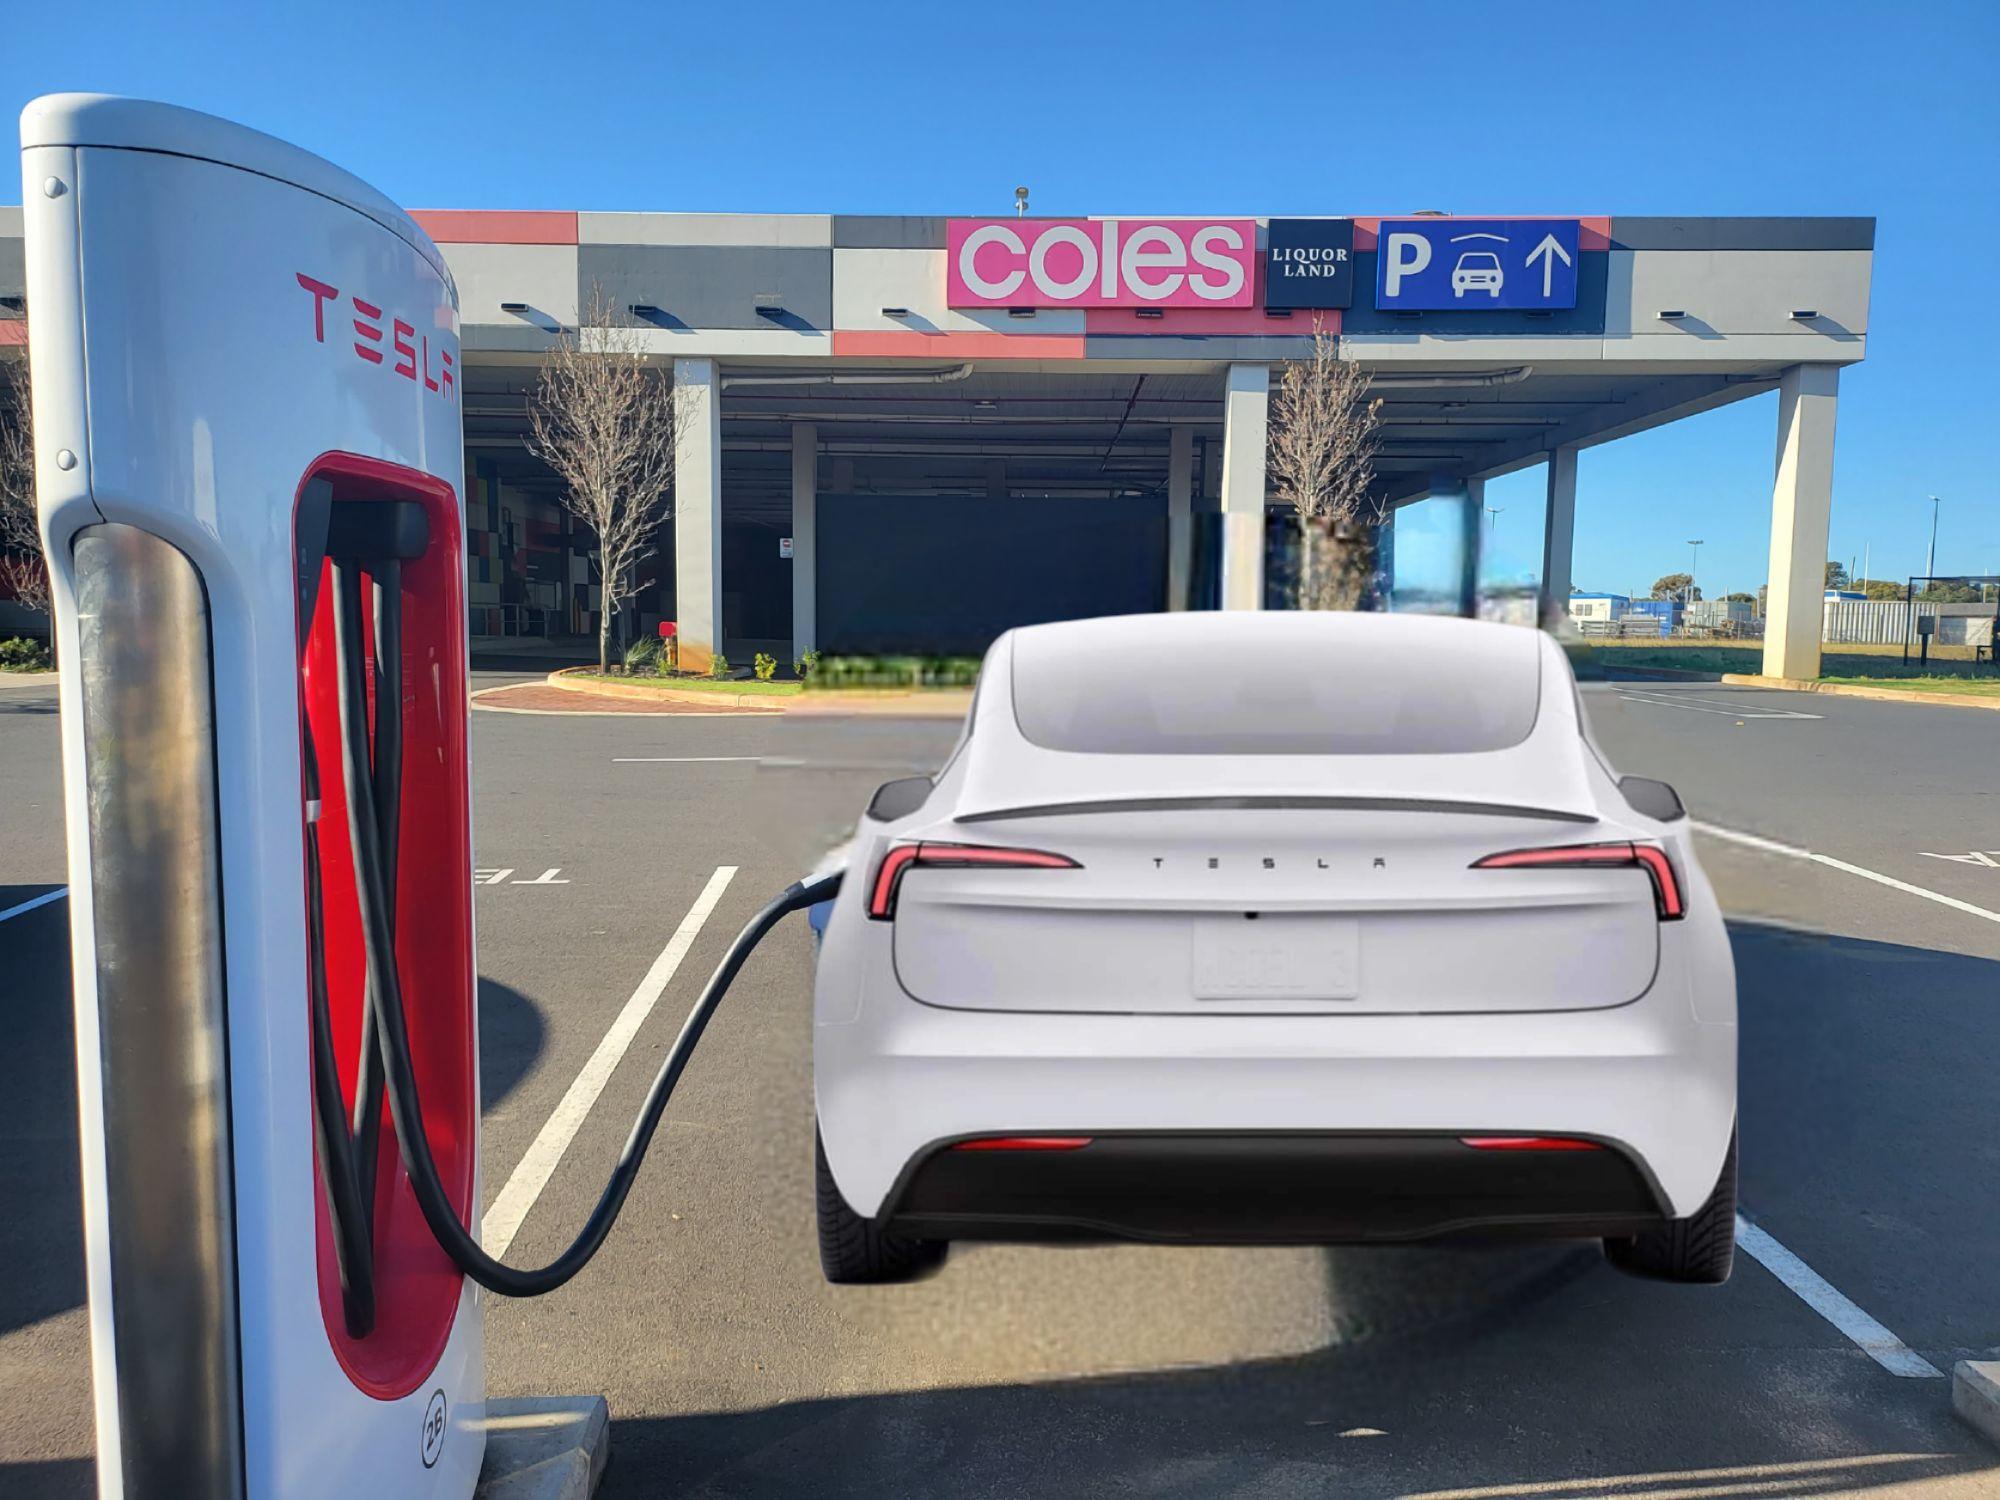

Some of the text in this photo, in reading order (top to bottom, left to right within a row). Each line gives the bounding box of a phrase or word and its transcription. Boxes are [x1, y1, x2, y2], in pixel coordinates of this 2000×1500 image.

[959, 221, 1244, 300] coles
[1272, 248, 1348, 264] LIQUOR
[1284, 264, 1336, 277] LAND
[1385, 233, 1432, 297] P
[296, 272, 454, 403] TESLA
[1153, 858, 1385, 869] TESLA
[426, 1406, 443, 1452] 2B
